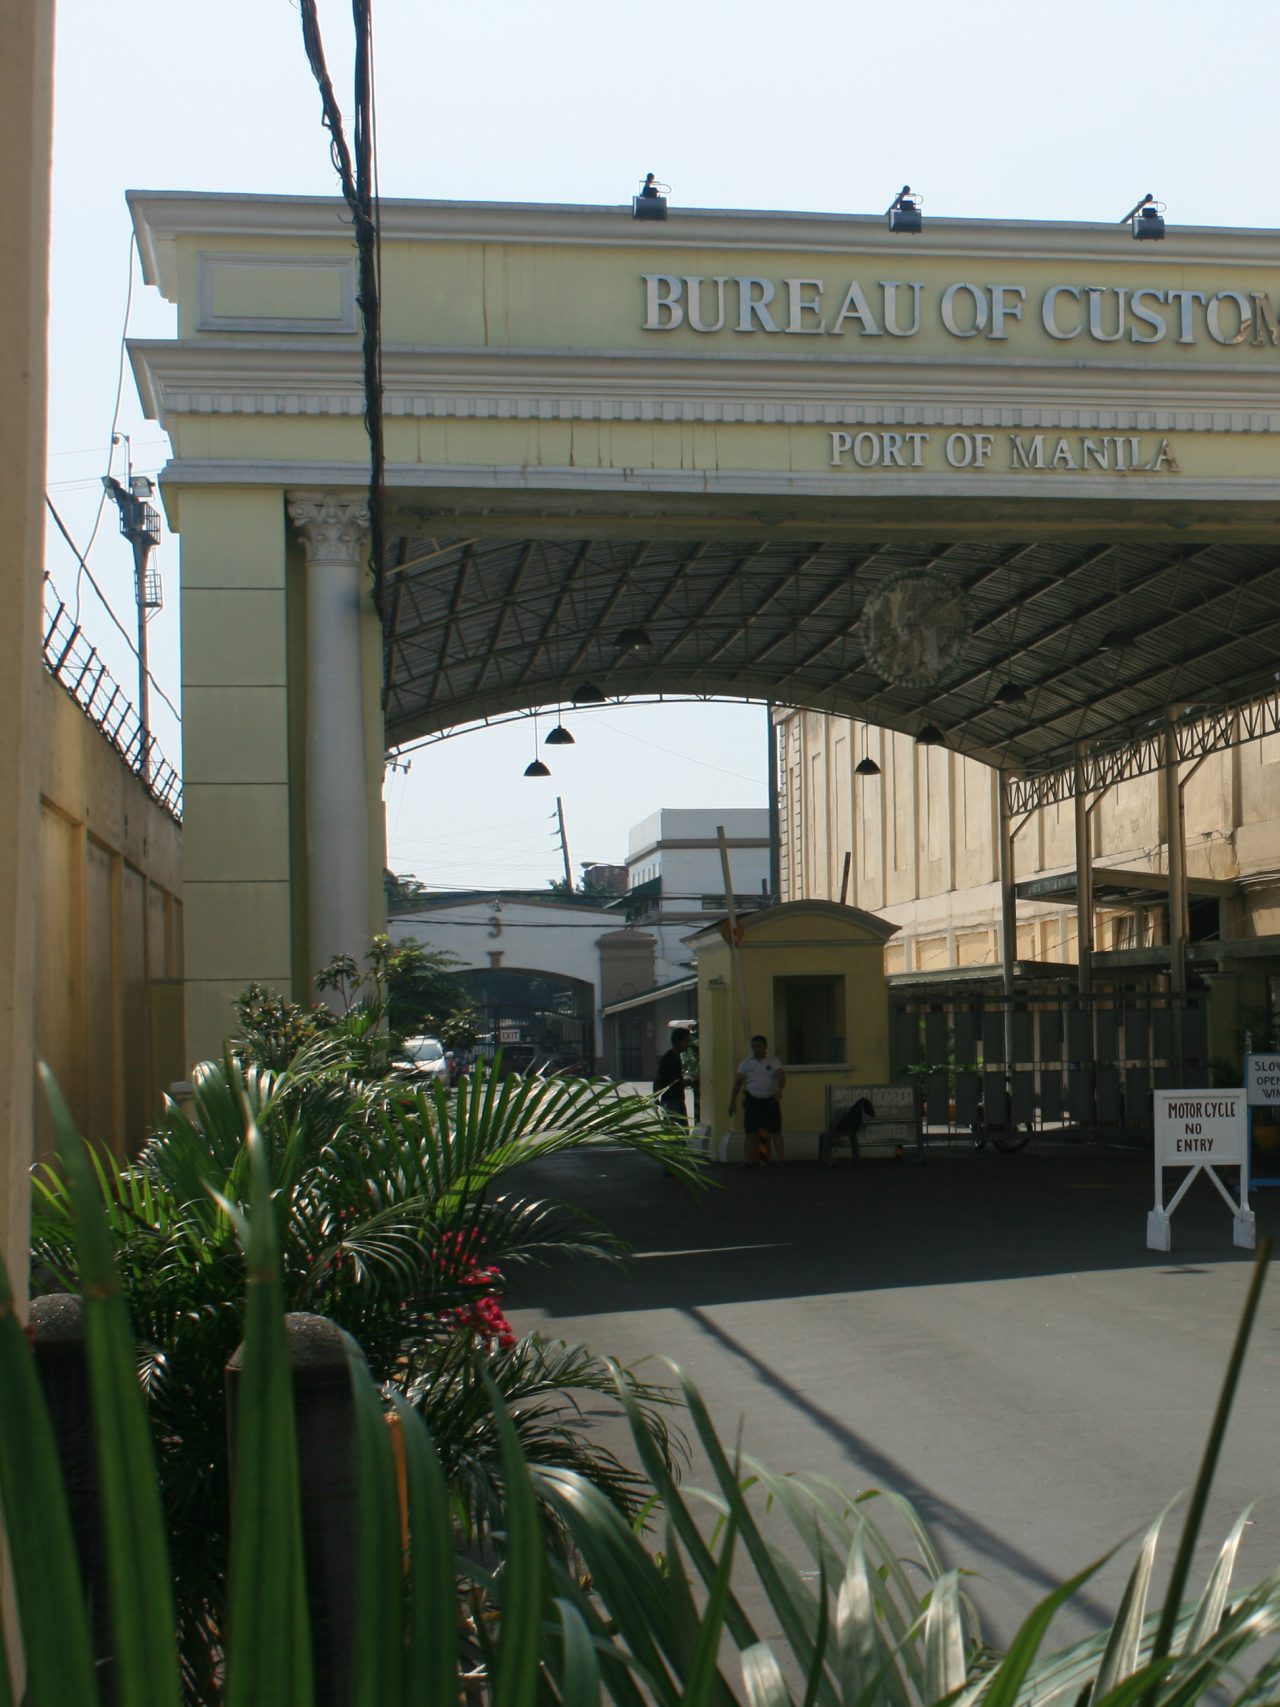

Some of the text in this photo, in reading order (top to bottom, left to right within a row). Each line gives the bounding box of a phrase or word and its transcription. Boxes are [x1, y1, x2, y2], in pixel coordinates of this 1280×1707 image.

[641, 273, 925, 338] BUREAU
[941, 282, 1026, 341] OF
[829, 430, 1182, 474] PORT OF MANILA
[501, 1031, 519, 1040] EXIT
[1185, 1122, 1202, 1135] NO
[1176, 1138, 1214, 1153] ENTRY
